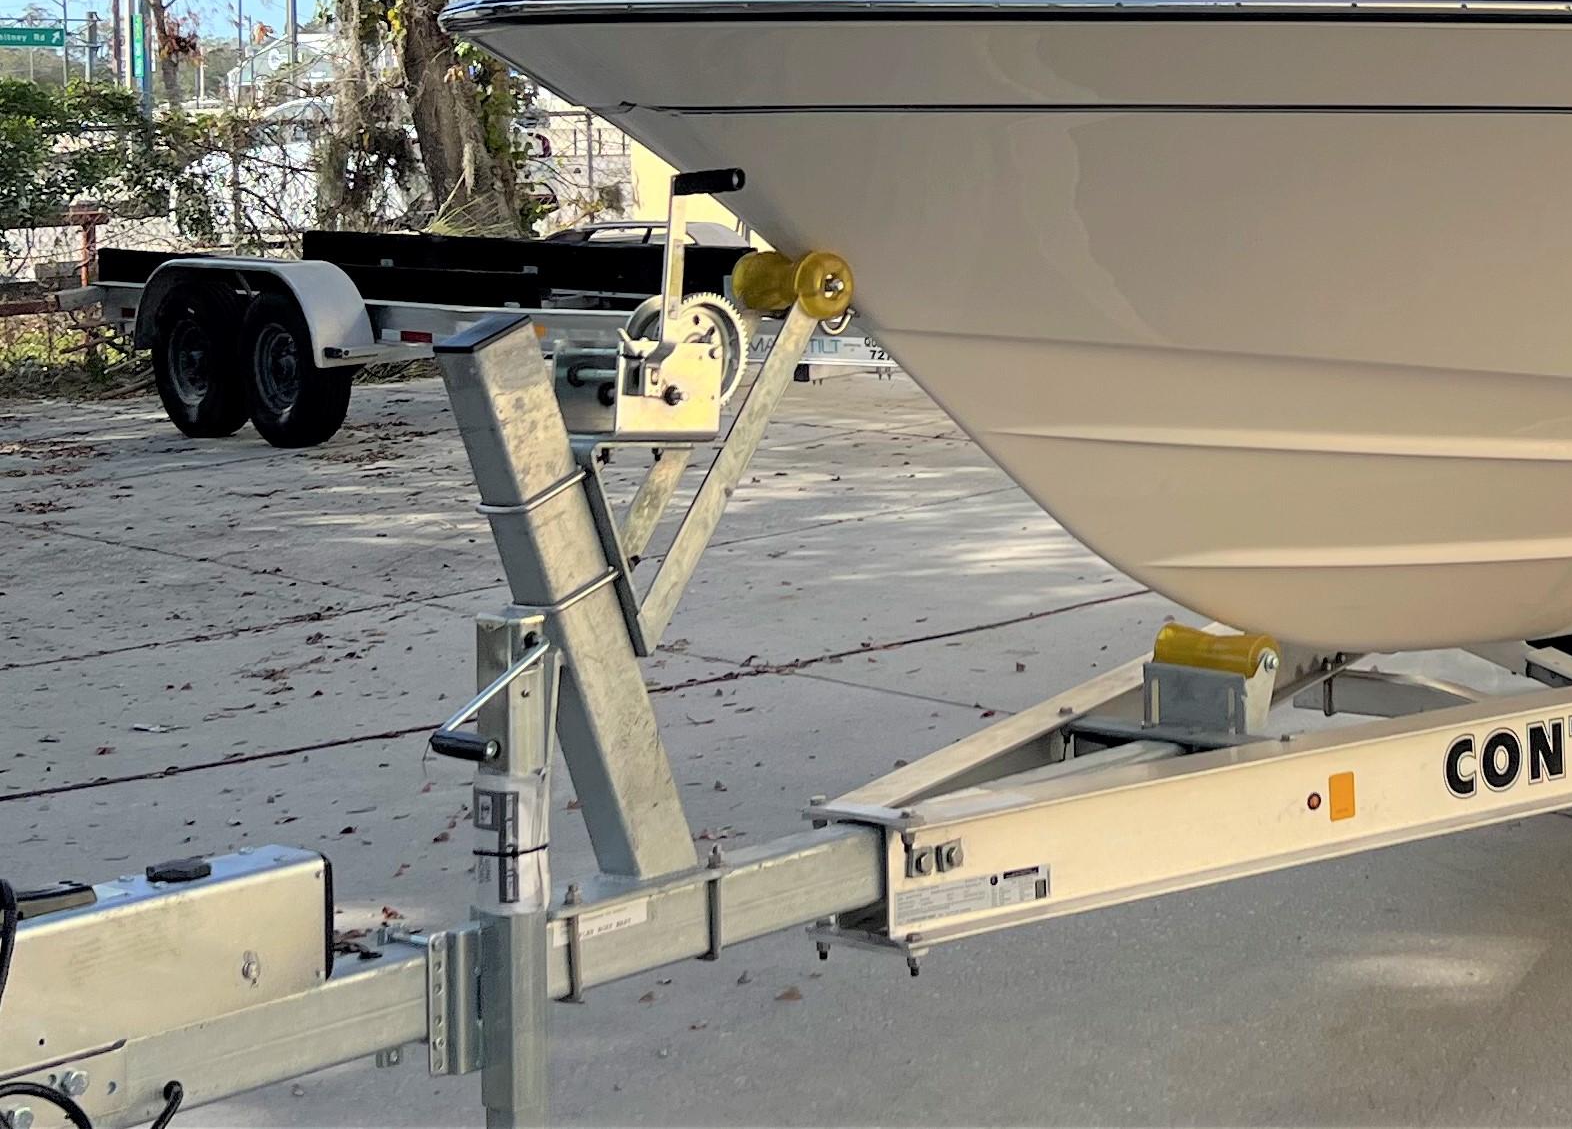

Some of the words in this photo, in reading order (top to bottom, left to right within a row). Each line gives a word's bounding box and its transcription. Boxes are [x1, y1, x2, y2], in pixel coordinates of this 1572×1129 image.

[33, 33, 46, 42] Rd
[809, 338, 841, 353] TILT
[870, 350, 890, 360] 72
